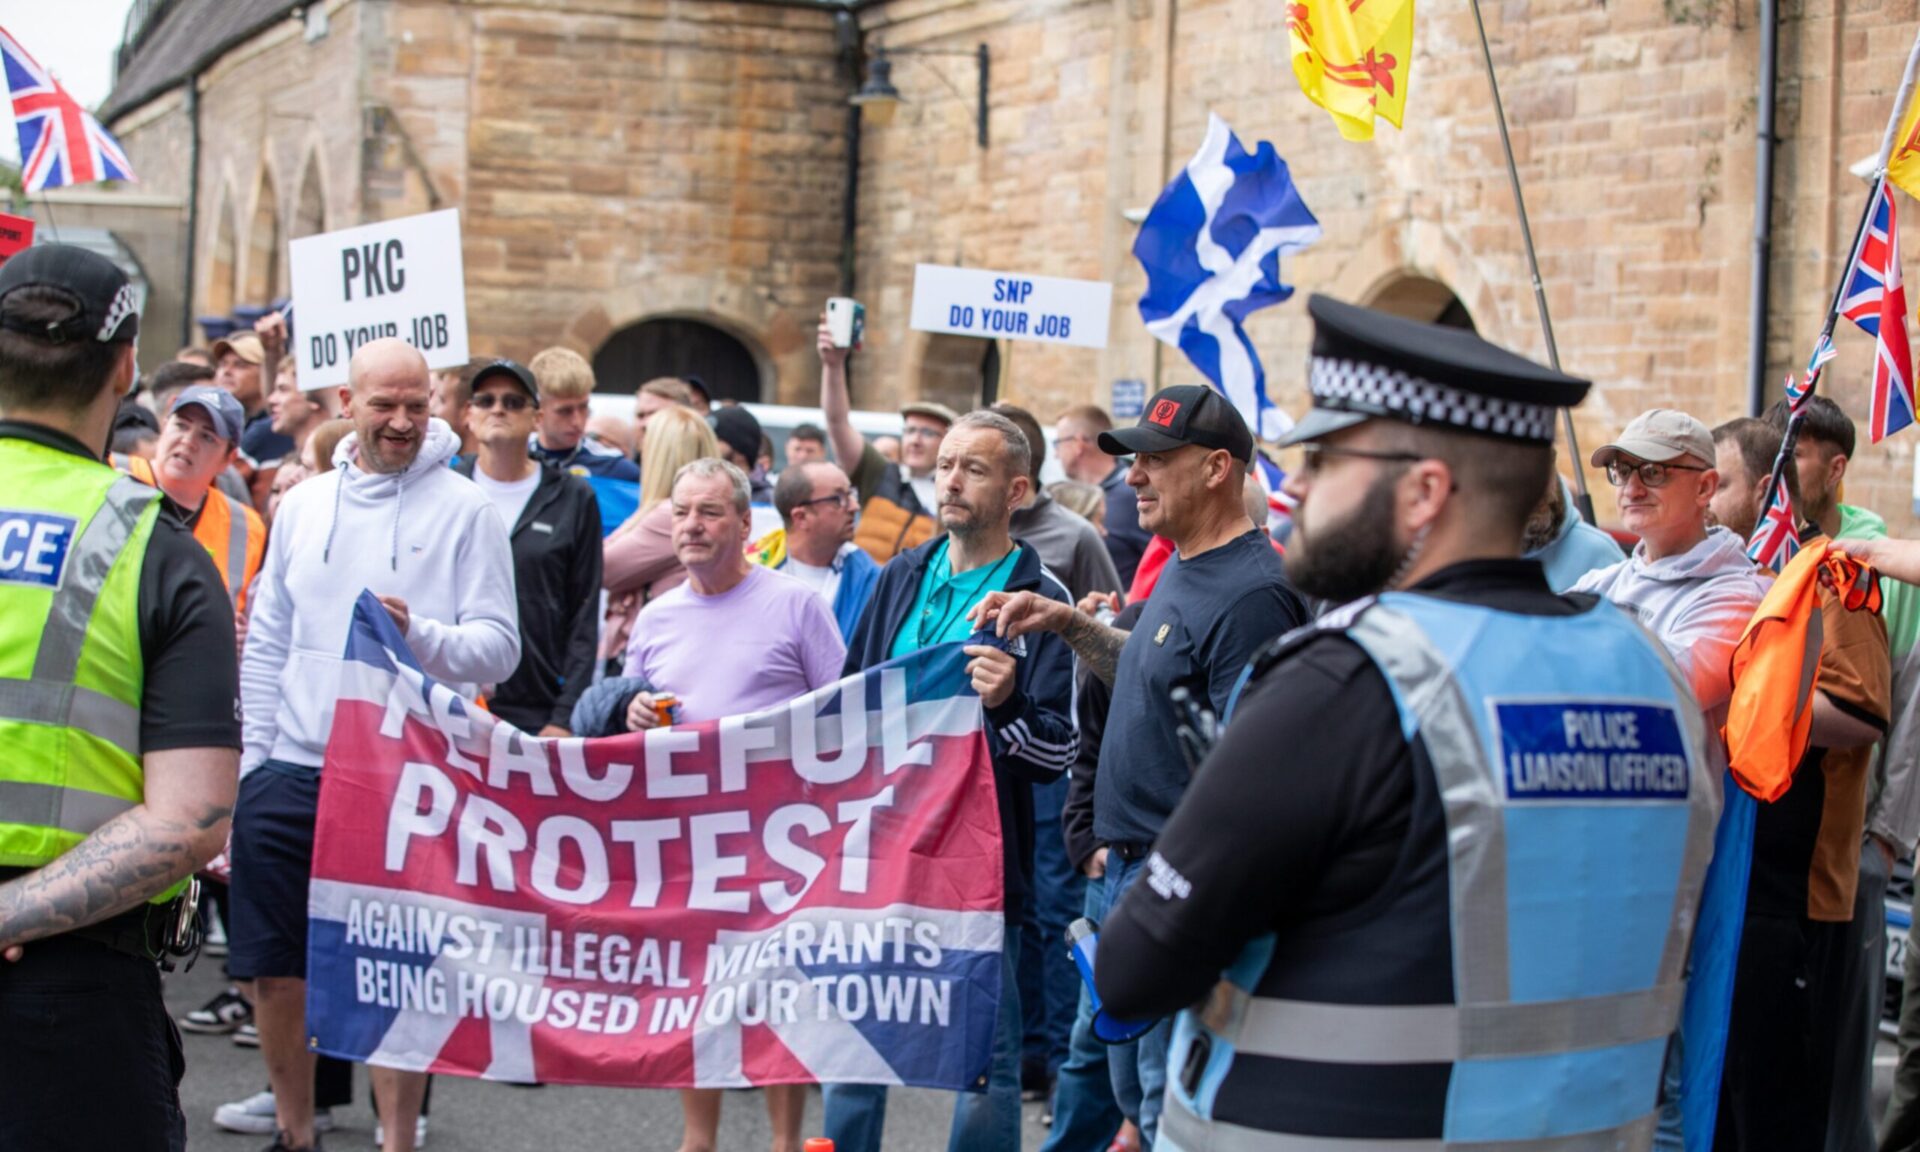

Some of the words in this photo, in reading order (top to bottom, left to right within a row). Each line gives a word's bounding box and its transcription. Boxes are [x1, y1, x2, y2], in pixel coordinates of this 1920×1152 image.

[342, 239, 405, 301] PKC
[994, 279, 1033, 304] SNP
[311, 333, 337, 369] DO
[406, 313, 449, 350] JOB
[950, 305, 974, 328] DO
[982, 308, 1028, 334] YOUR
[1035, 314, 1071, 338] JOB
[1562, 710, 1641, 749] POLICE
[1510, 752, 1607, 791] LIAISON
[1609, 754, 1687, 791] OFFICER
[385, 762, 894, 915] PROTEST
[346, 899, 503, 965] AGAINST
[512, 925, 690, 988] ILLEGAL
[703, 917, 942, 983] MIGRANTS
[356, 956, 447, 1015] BEING
[458, 971, 638, 1035] HOUSED
[650, 995, 697, 1034] IN
[704, 978, 800, 1026] OUR
[811, 974, 950, 1027] TOWN
